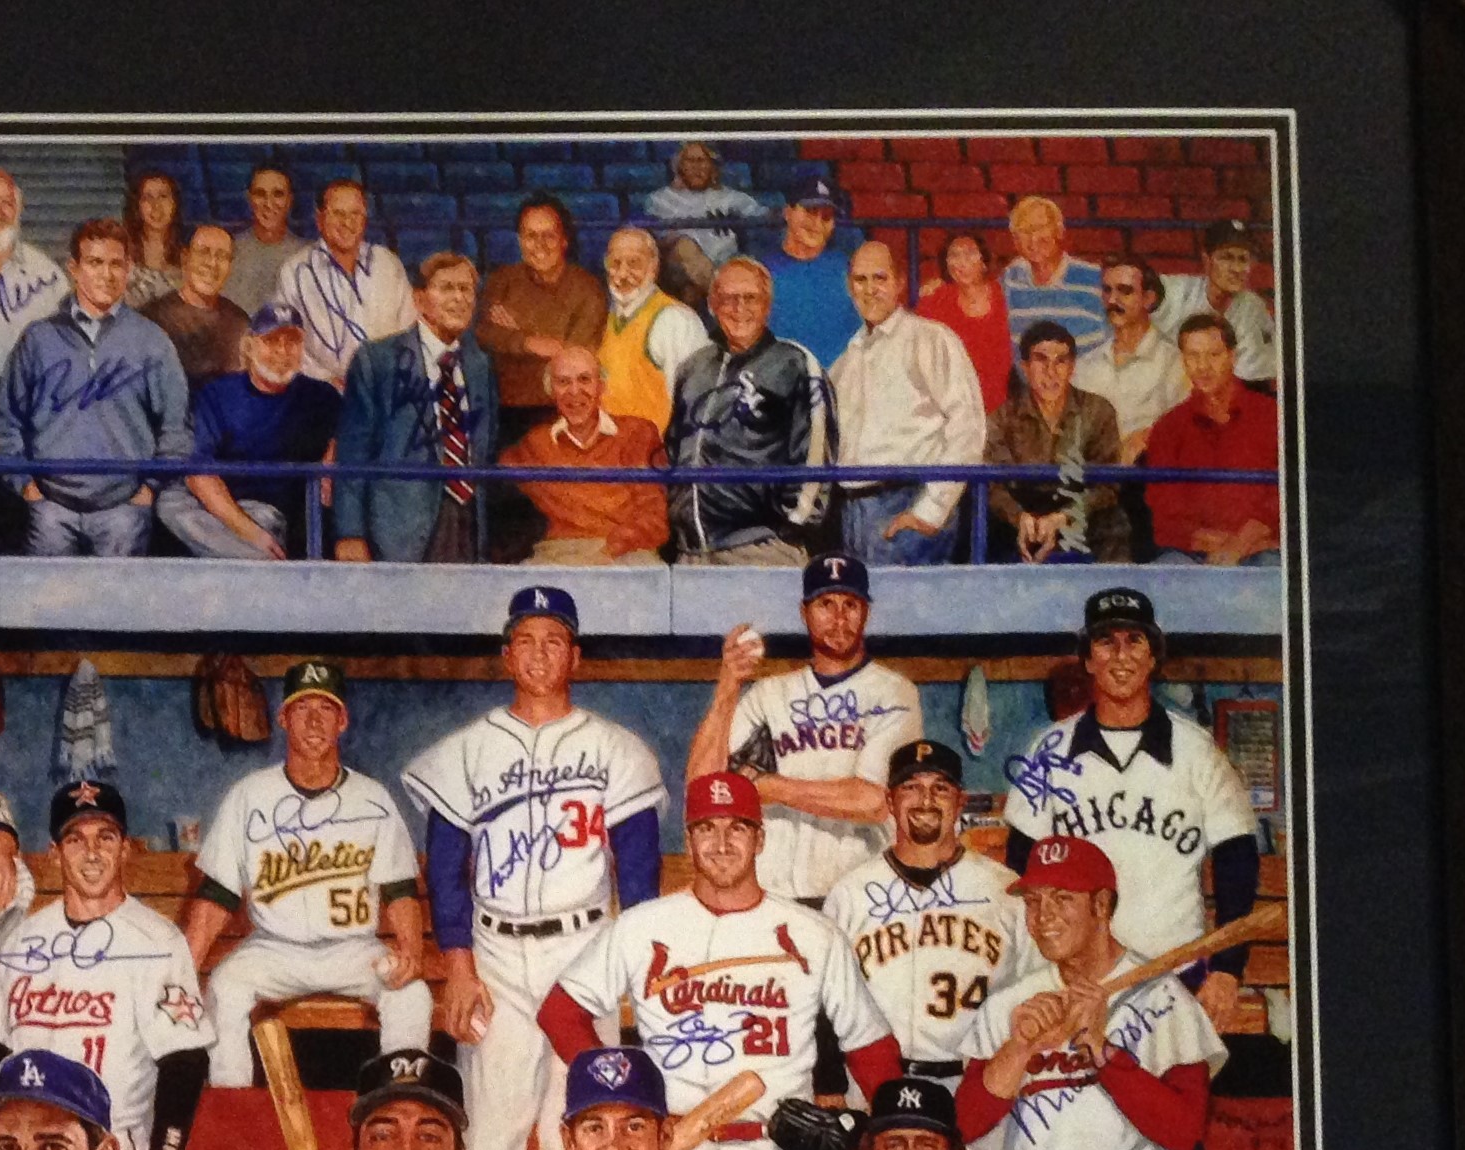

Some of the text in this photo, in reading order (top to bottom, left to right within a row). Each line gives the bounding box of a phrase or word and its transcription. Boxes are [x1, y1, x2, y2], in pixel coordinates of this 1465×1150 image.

[823, 557, 847, 580] T
[916, 745, 933, 763] P
[557, 799, 608, 850] 34
[329, 888, 370, 928] 56
[853, 914, 1003, 981] PIRATES
[8, 975, 115, 1023] Astros
[658, 976, 789, 1015] Cardinals
[926, 973, 991, 1019] 34
[743, 1016, 789, 1056] 21
[20, 1060, 46, 1087] LA
